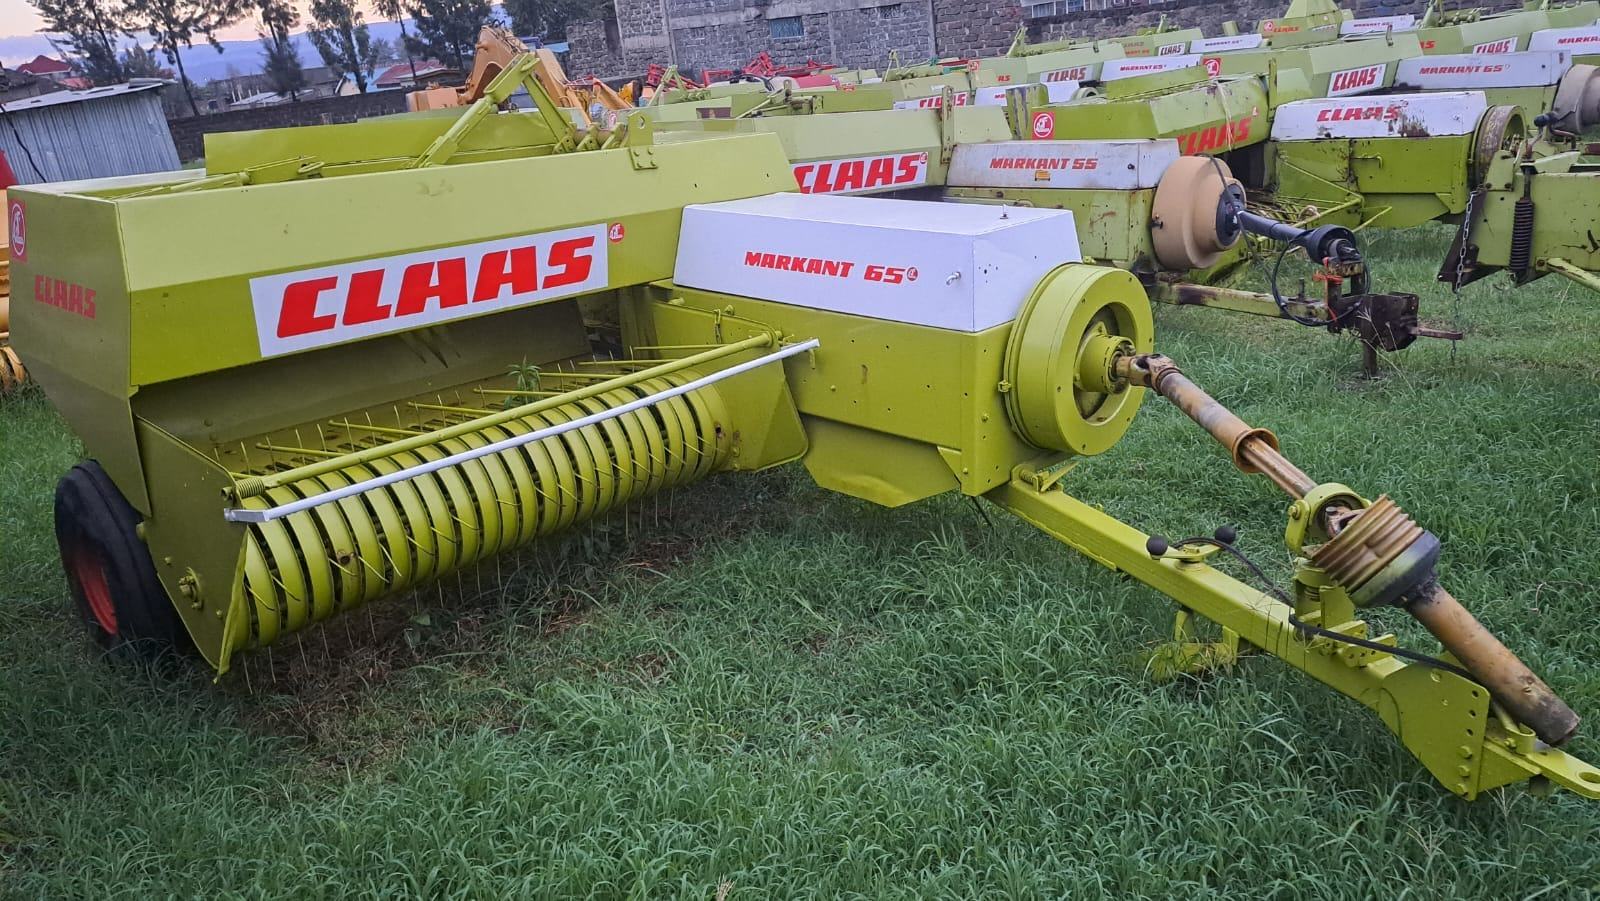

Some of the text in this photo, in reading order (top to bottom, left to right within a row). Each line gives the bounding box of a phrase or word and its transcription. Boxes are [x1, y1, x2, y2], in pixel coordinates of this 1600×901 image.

[1160, 44, 1182, 55] CLAAS
[1558, 36, 1600, 44] MARKA
[1332, 67, 1378, 91] CLAAS
[1419, 66, 1481, 74] MARKANT
[1316, 105, 1401, 122] CLAAS
[990, 158, 1098, 169] MARKANT 55
[793, 154, 921, 194] CLAAS
[745, 251, 906, 285] MARKANT 65
[34, 274, 97, 320] CLAAS
[276, 235, 595, 339] CLAAS
